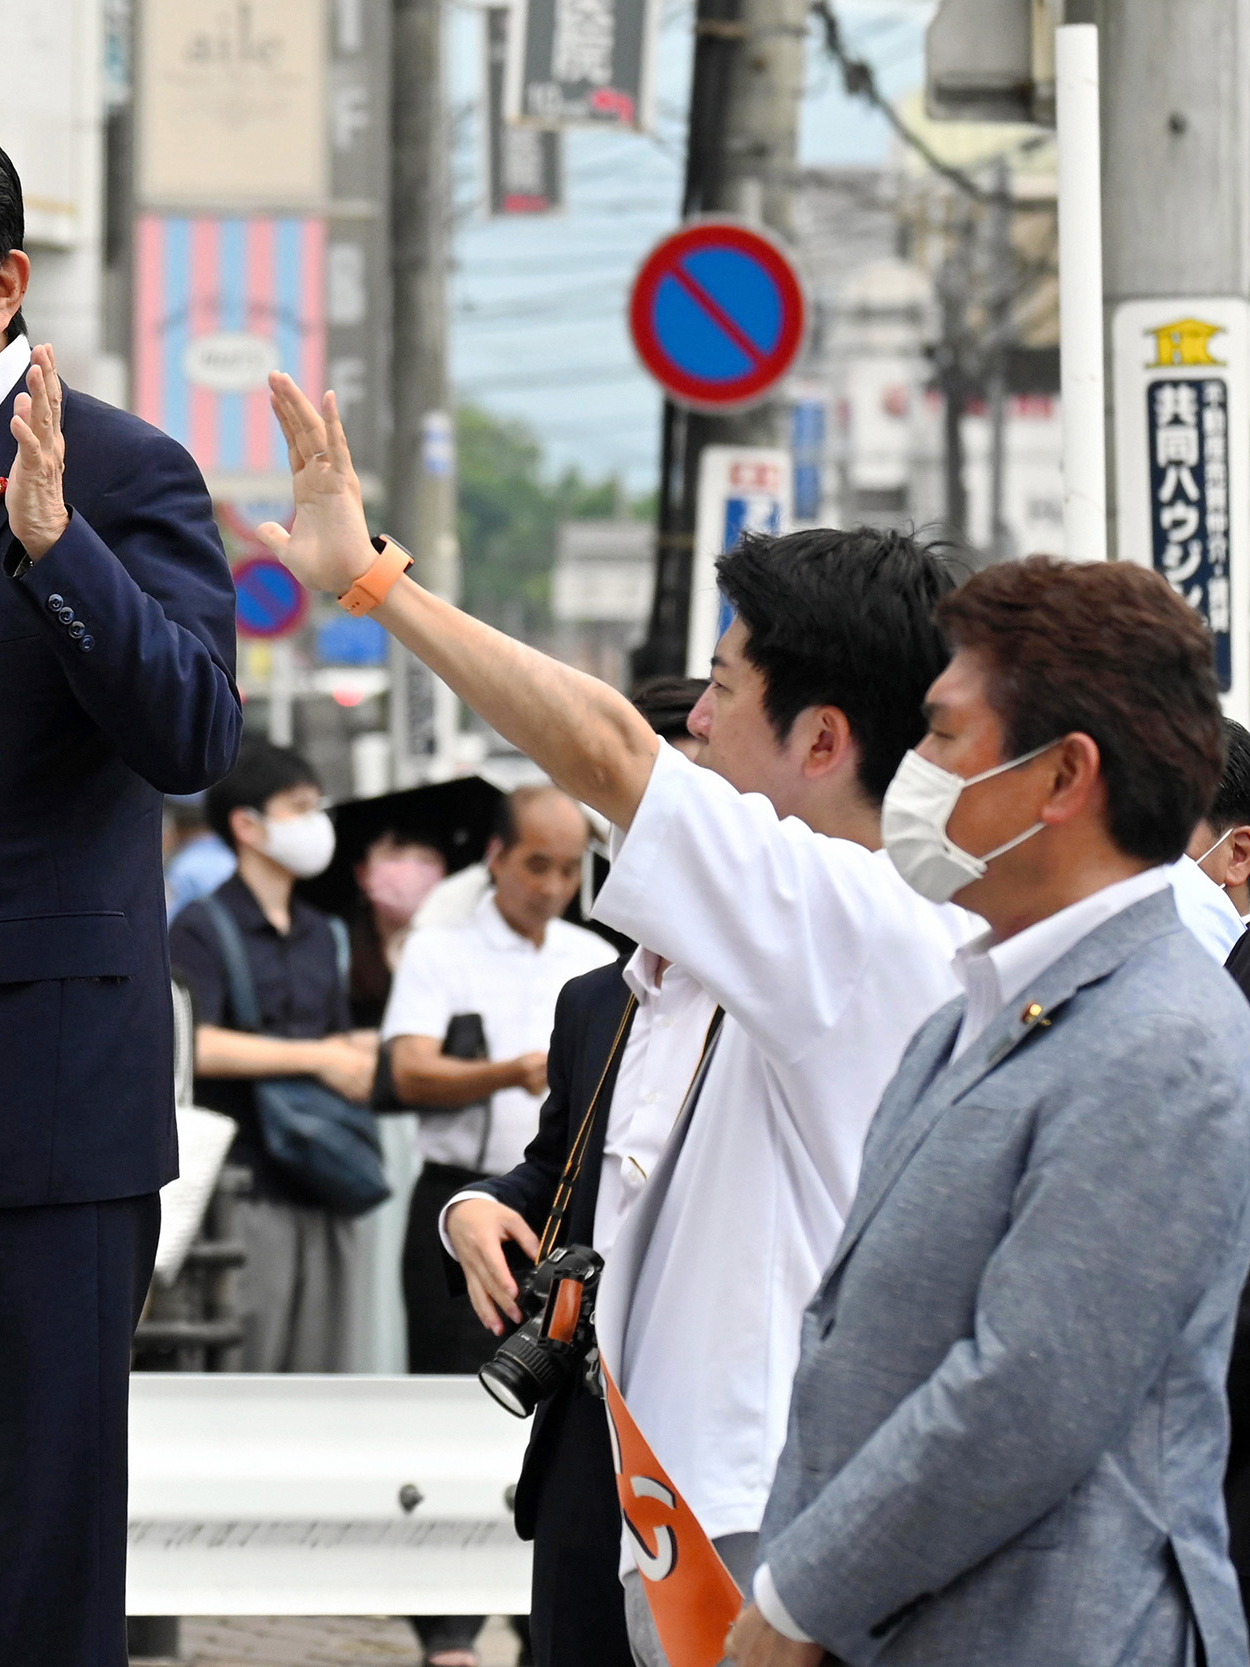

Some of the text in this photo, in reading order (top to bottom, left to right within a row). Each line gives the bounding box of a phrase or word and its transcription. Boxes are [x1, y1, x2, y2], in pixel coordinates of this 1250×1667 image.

[1155, 383, 1207, 625] 共同ハウジ
